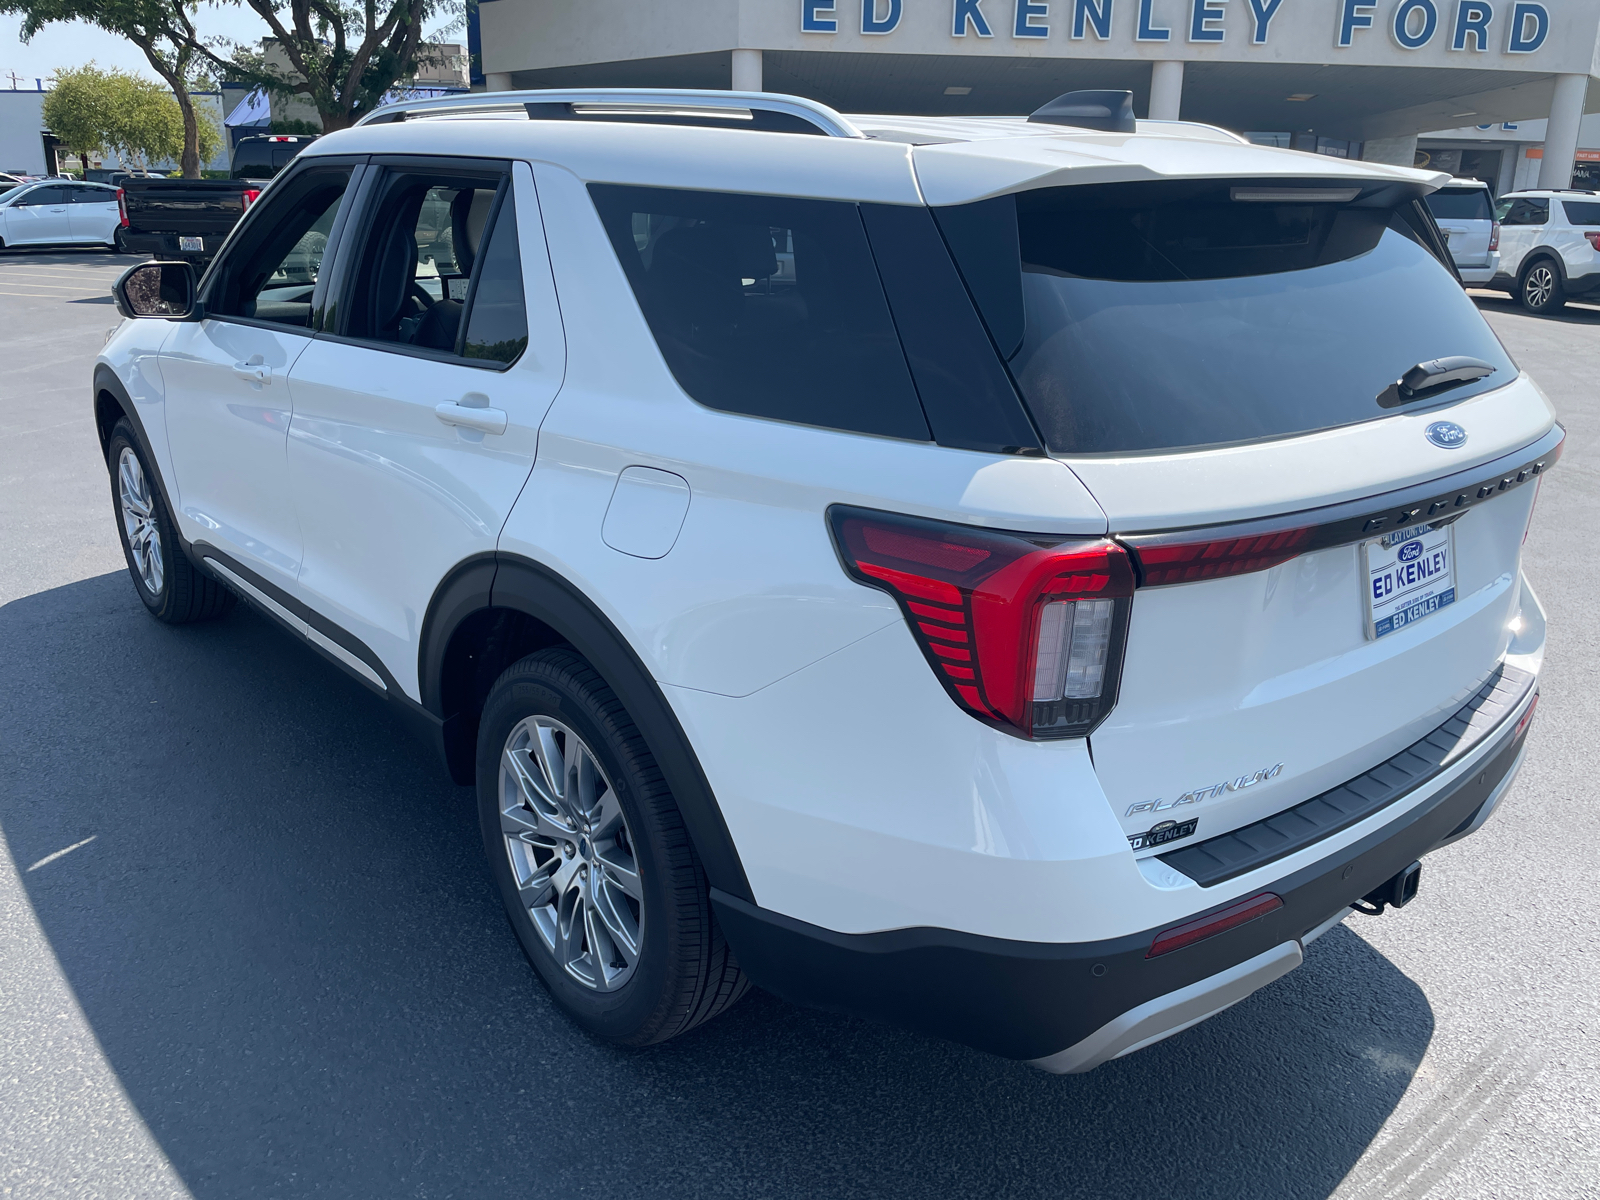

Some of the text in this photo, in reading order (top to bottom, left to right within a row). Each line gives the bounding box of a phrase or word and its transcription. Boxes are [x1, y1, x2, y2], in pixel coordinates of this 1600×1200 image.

[800, 0, 1551, 54] ED KENLEY FORD
[1430, 422, 1467, 445] Ford
[1401, 542, 1421, 561] Ford
[1373, 549, 1448, 599] ED KENLEY
[1392, 612, 1405, 629] ED
[1407, 595, 1440, 623] KENLEY
[1124, 762, 1285, 817] PLATINUM
[1146, 822, 1197, 846] KENLEY
